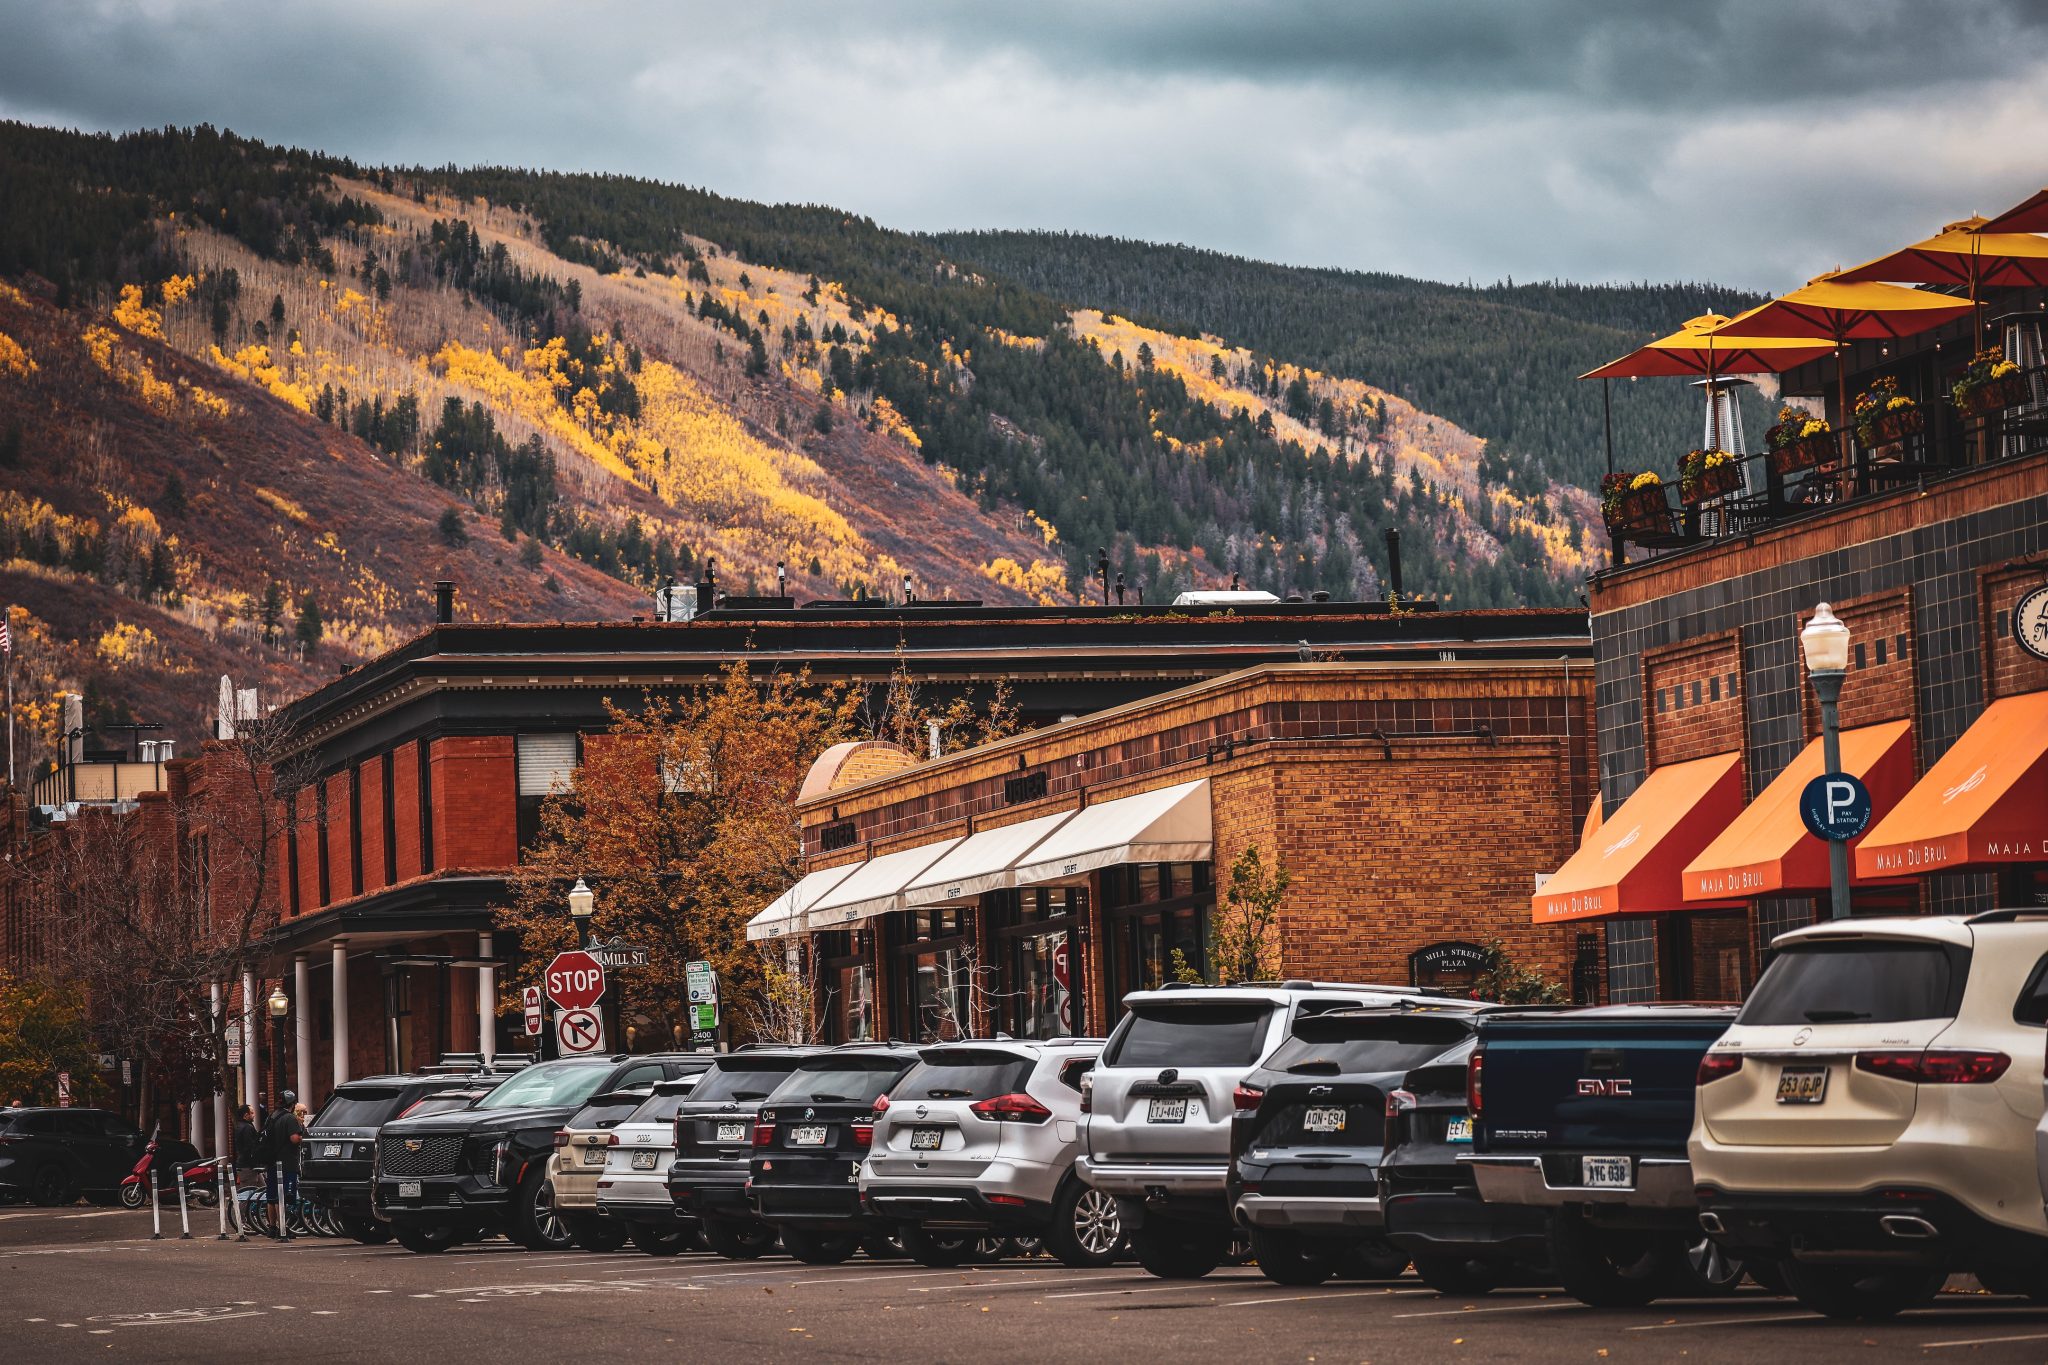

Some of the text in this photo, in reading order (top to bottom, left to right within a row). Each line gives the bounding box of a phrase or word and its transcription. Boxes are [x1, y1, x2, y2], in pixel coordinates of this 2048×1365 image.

[1826, 781, 1856, 825] P
[1858, 807, 1871, 830] VEHICLE
[1877, 844, 1947, 870] MAJA DU BRUL
[1988, 842, 2031, 855] MAJA
[1701, 871, 1763, 893] MAJA DU BRUL
[1548, 895, 1602, 915] MAJA DU BRUL
[604, 952, 630, 966] MILL
[631, 950, 645, 964] ST
[1425, 949, 1484, 962] MILL STREET
[550, 968, 600, 994] STOP
[526, 997, 532, 1005] DO
[693, 1031, 711, 1039] 2400
[1576, 1078, 1631, 1096] GMC
[1780, 1077, 1821, 1092] 253 GJP
[1495, 1130, 1547, 1139] SIERRA
[1589, 1165, 1606, 1182] AYG
